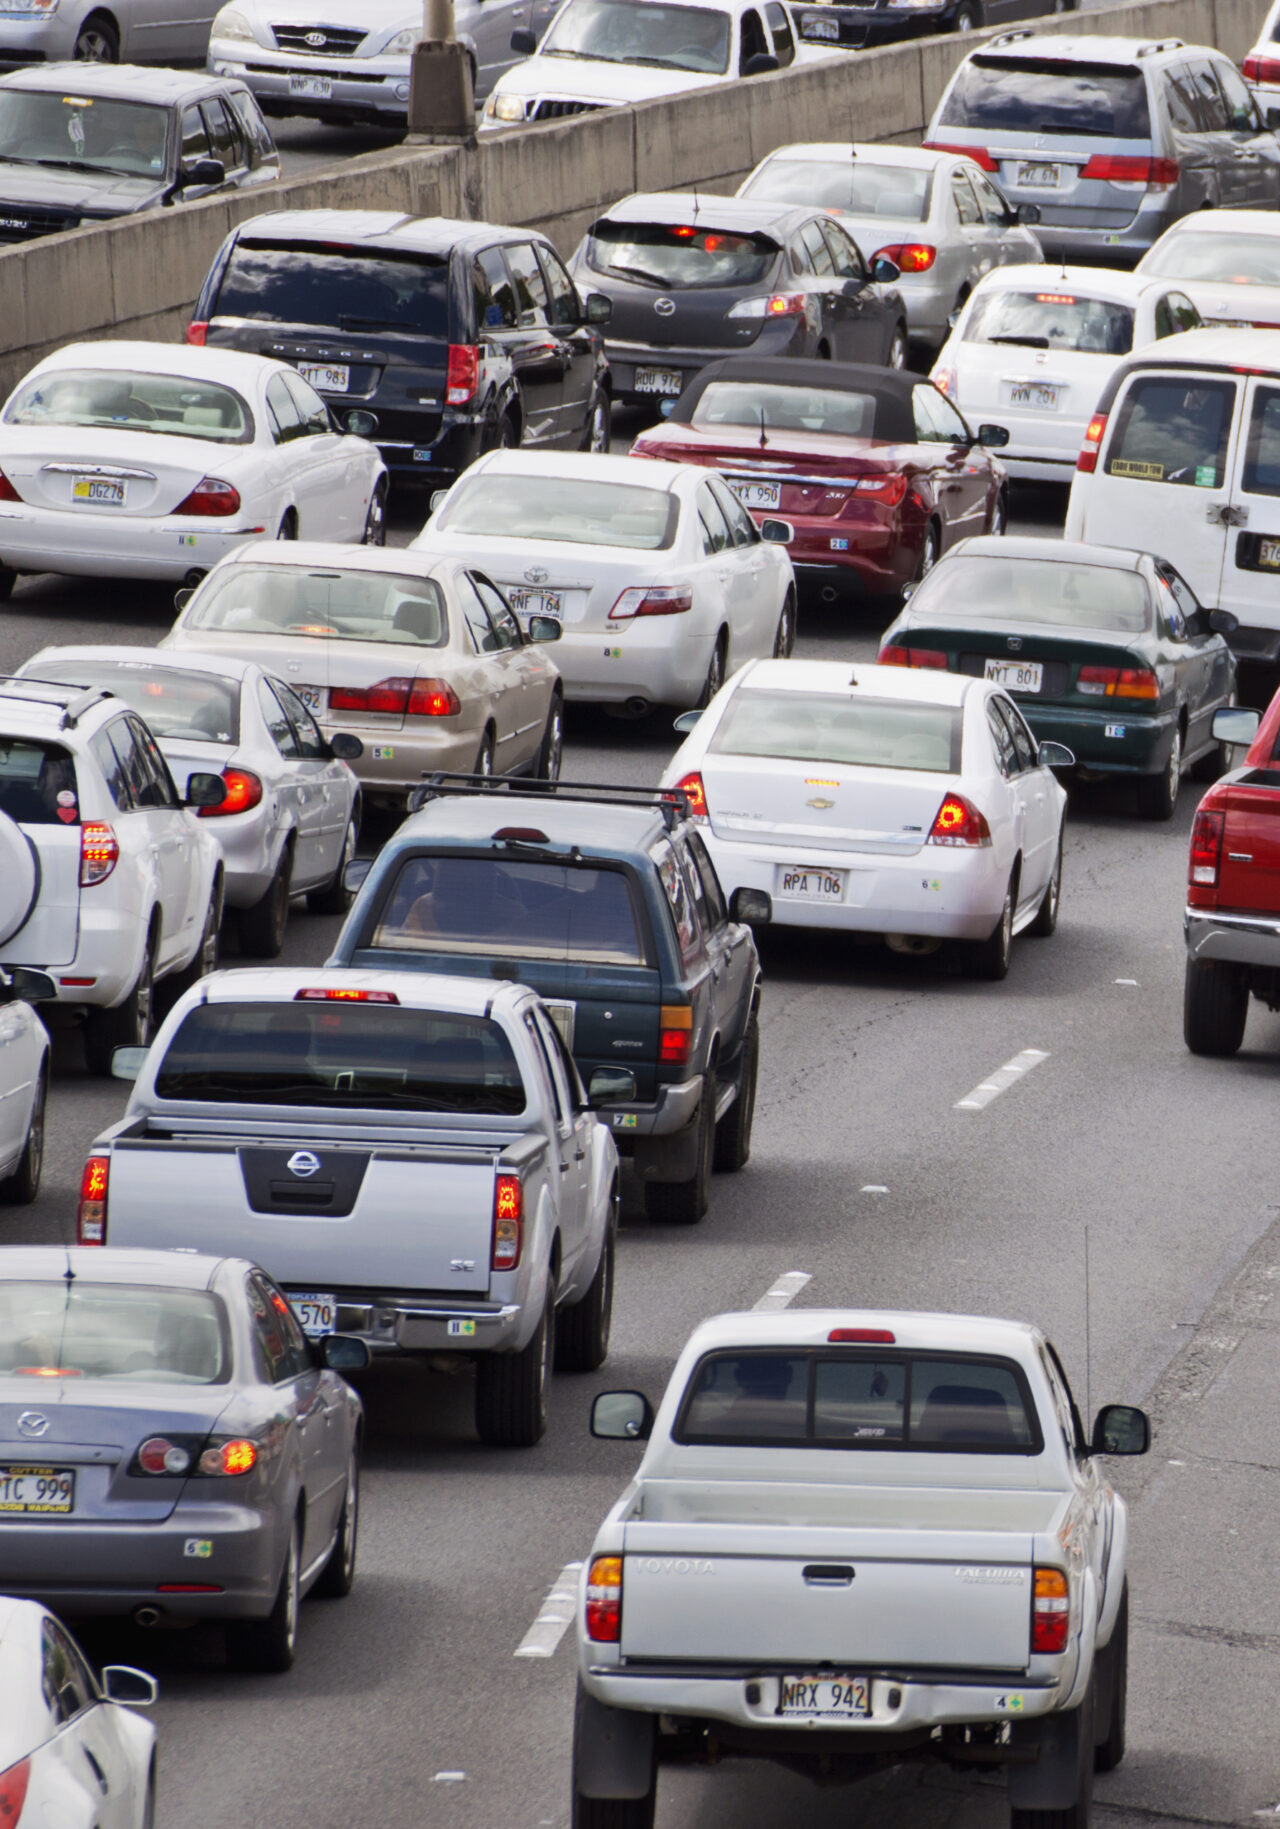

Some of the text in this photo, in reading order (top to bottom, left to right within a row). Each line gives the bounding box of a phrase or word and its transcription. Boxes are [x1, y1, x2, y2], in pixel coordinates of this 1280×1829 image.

[0, 218, 28, 229] SUZU
[325, 369, 346, 385] 983
[757, 487, 778, 502] 950
[509, 593, 560, 612] RNF 164
[986, 666, 1039, 684] NYT 801
[783, 873, 841, 894] RPA 106
[450, 1260, 475, 1272] SE
[301, 1304, 331, 1326] 570
[9, 1466, 54, 1476] CUTTER
[0, 1477, 70, 1500] TC 999
[636, 1559, 717, 1576] TOYOTA
[783, 1683, 865, 1709] NRX 942
